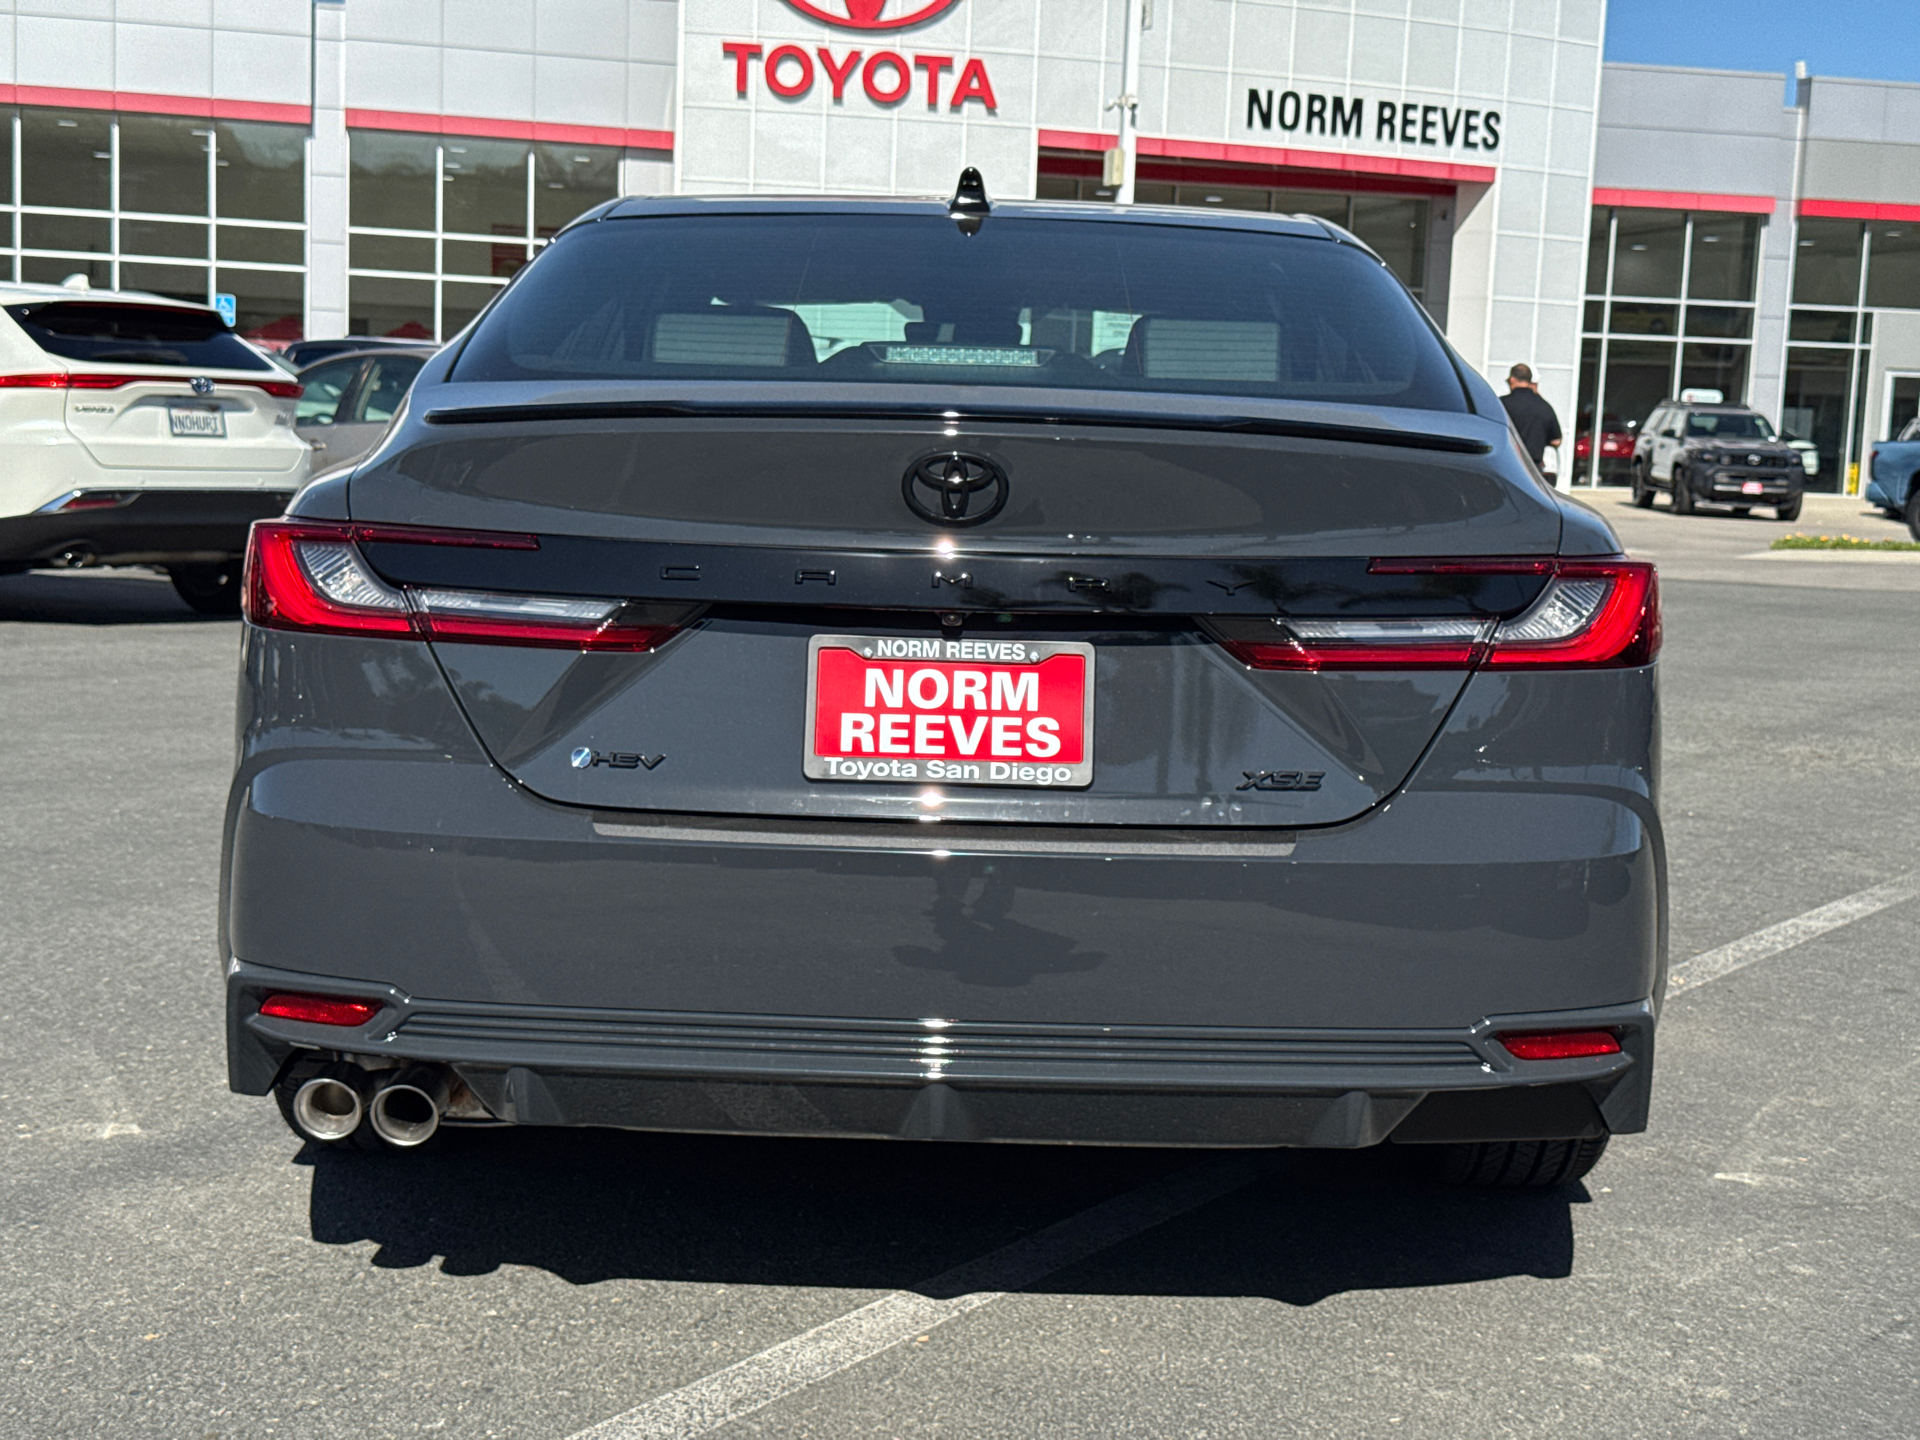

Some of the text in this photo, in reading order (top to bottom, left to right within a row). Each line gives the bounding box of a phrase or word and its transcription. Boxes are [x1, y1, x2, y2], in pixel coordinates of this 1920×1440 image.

[722, 42, 998, 112] TOYOTA
[1247, 88, 1501, 150] NORM REEVES
[660, 564, 1255, 596] CAMRY
[877, 639, 1026, 661] NORM REEVES
[864, 668, 1039, 711] NORM
[839, 712, 1062, 758] REEVES
[592, 751, 666, 770] HEV
[824, 756, 1073, 785] Toyota San Diego
[1235, 770, 1326, 791] XSE
